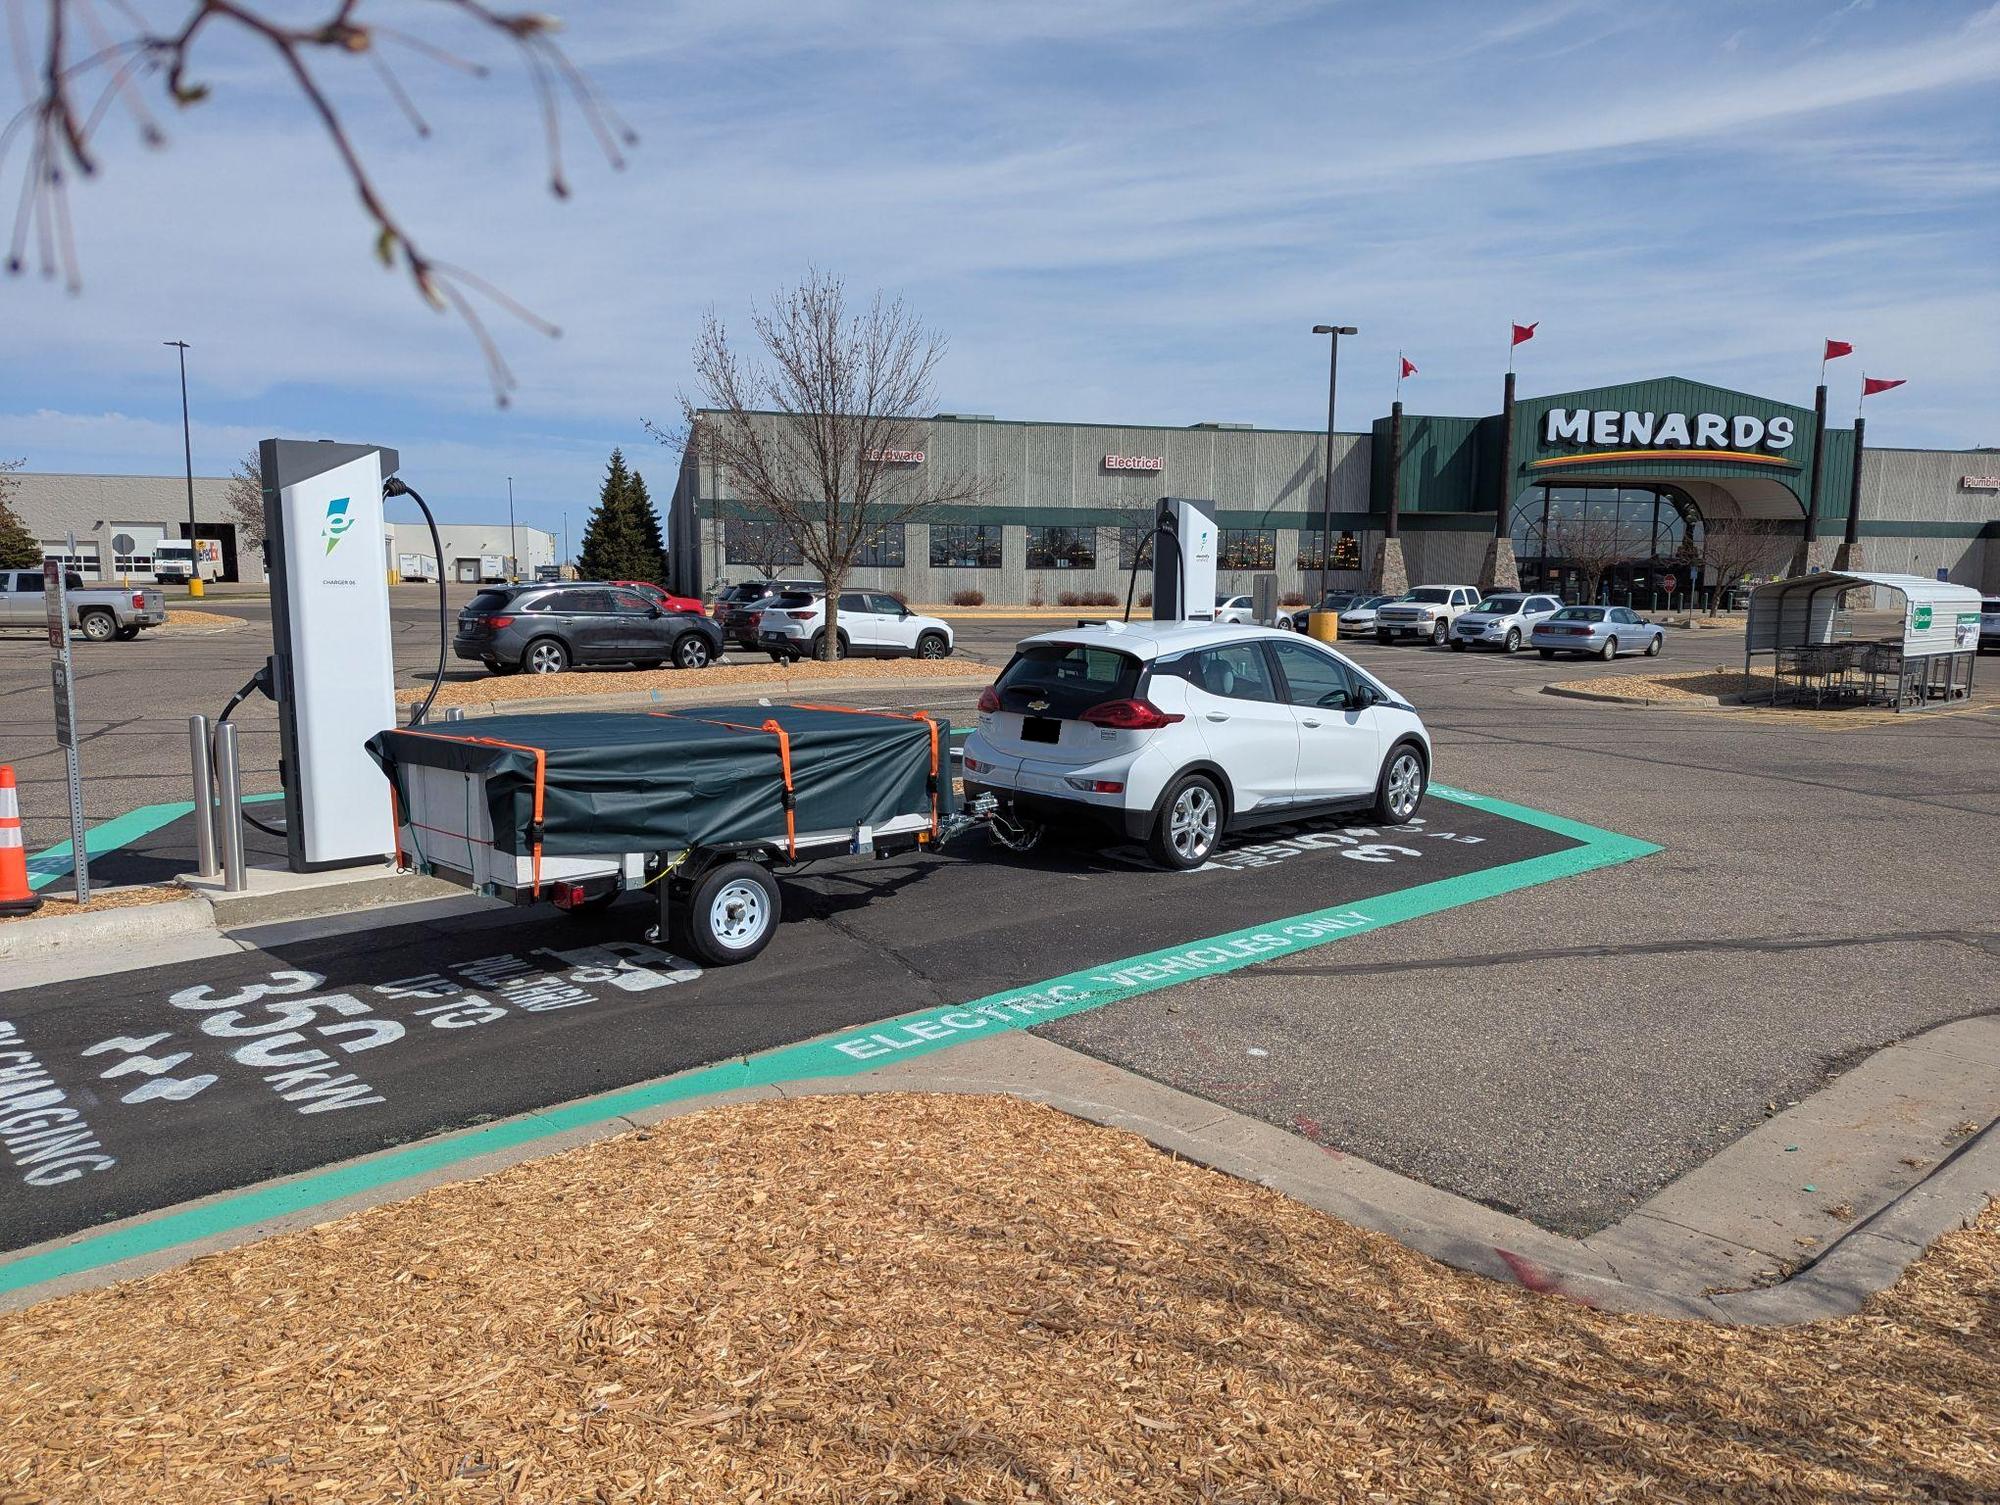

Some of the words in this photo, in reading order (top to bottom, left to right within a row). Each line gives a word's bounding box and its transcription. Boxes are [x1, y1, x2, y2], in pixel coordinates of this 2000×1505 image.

[1547, 408, 1795, 449] MENARDS
[1106, 455, 1163, 470] Electrical
[1964, 476, 2000, 489] Plumbin
[1427, 831, 1486, 844] EV
[373, 973, 465, 999] UP
[833, 985, 1082, 1060] ELECTRIC
[1091, 933, 1292, 987] VEHICLES
[1282, 910, 1375, 940] ONLY
[412, 995, 509, 1029] TO
